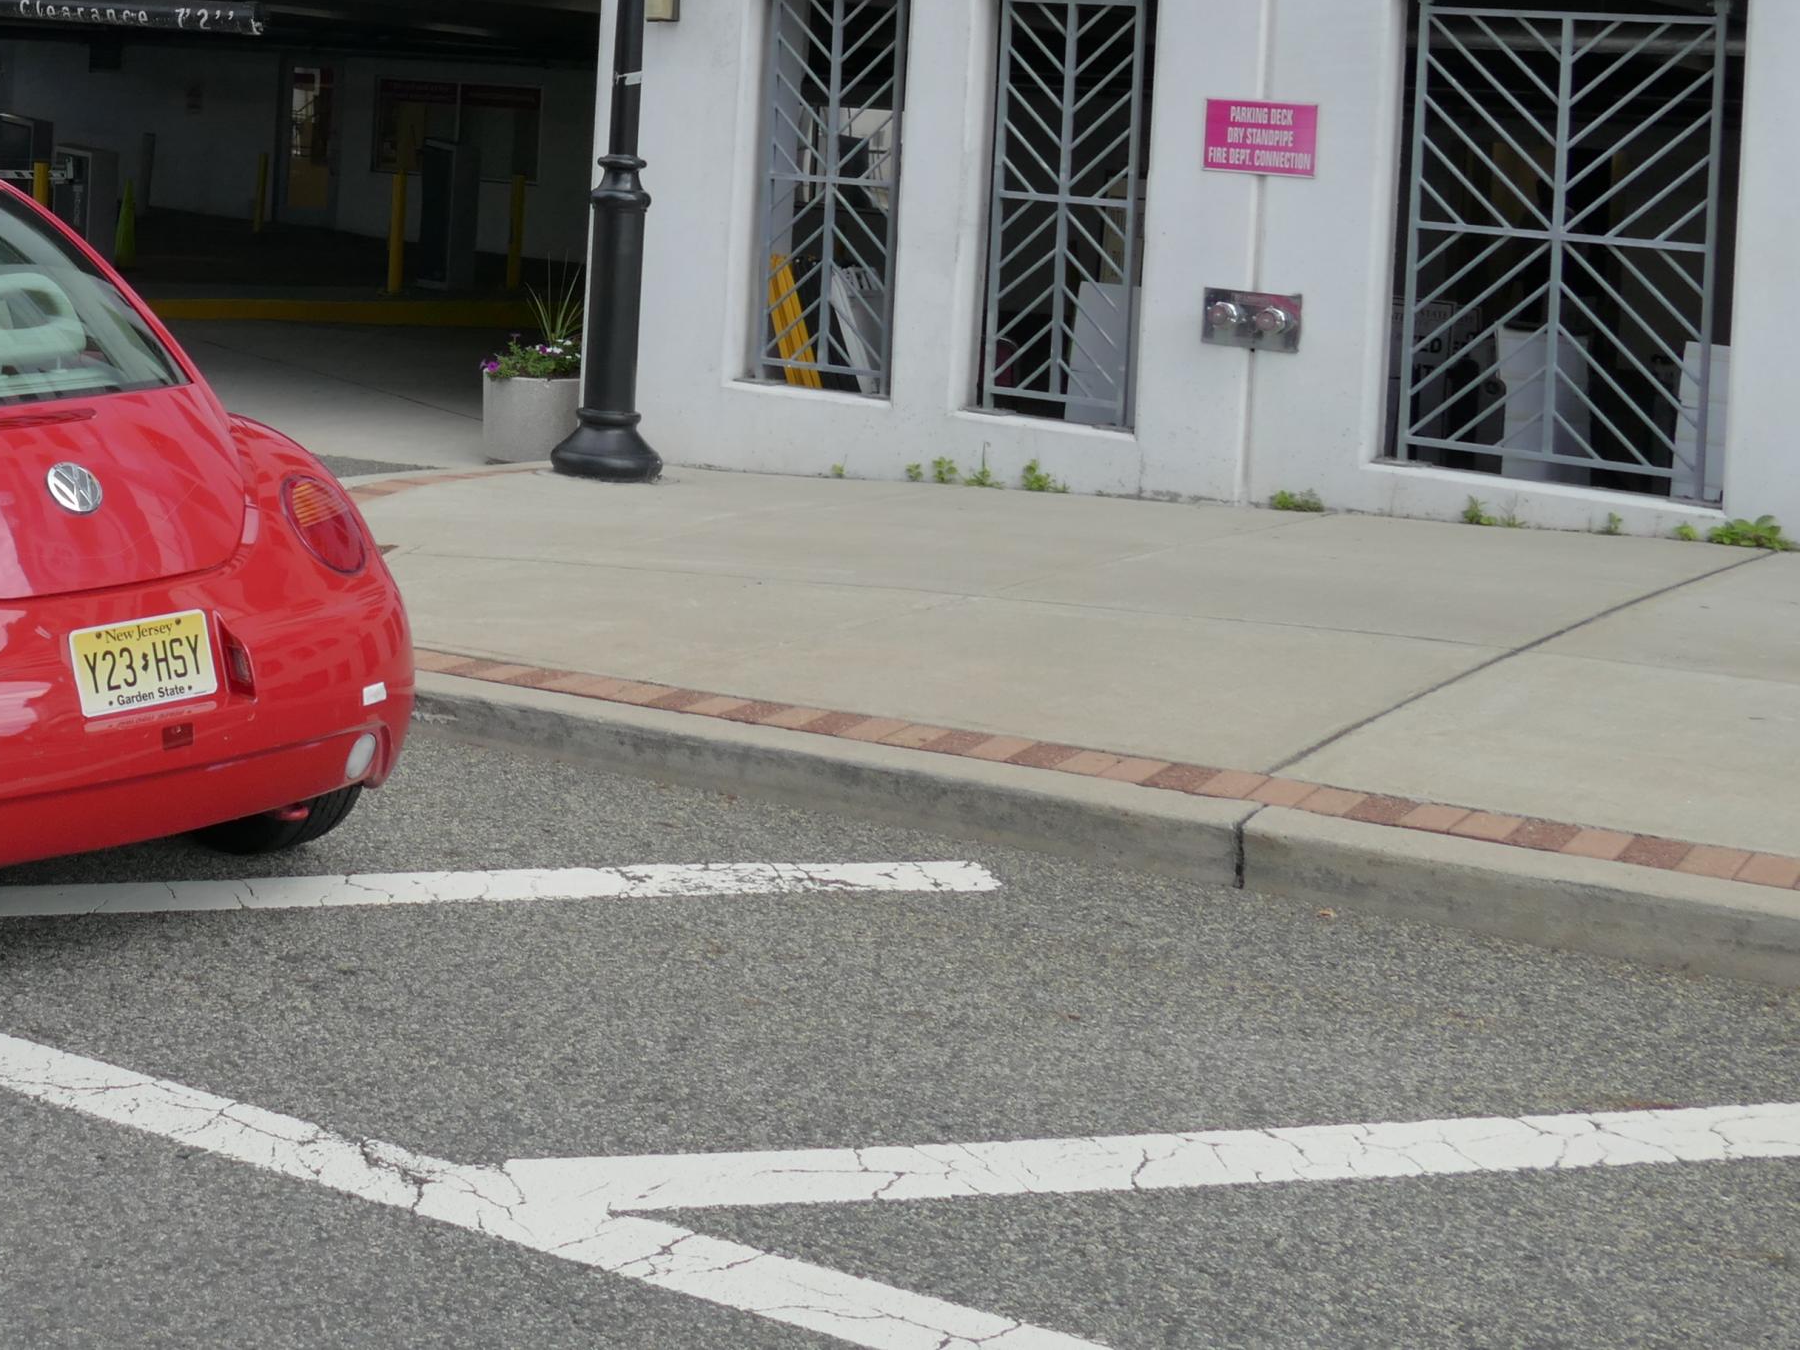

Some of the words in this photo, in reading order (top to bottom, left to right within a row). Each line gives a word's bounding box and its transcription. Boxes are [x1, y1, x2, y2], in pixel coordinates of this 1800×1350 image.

[1230, 106, 1268, 125] PARKING
[1270, 108, 1294, 126] DECK
[1227, 127, 1245, 144] DRY
[1246, 128, 1294, 147] STANDPIPE
[1208, 147, 1227, 163] FIRE
[1229, 148, 1252, 165] DEPT.
[1254, 150, 1312, 170] CONNECTION
[105, 629, 134, 643] New
[136, 623, 174, 641] Jersey
[117, 688, 155, 706] Garden
[158, 684, 185, 699] State
